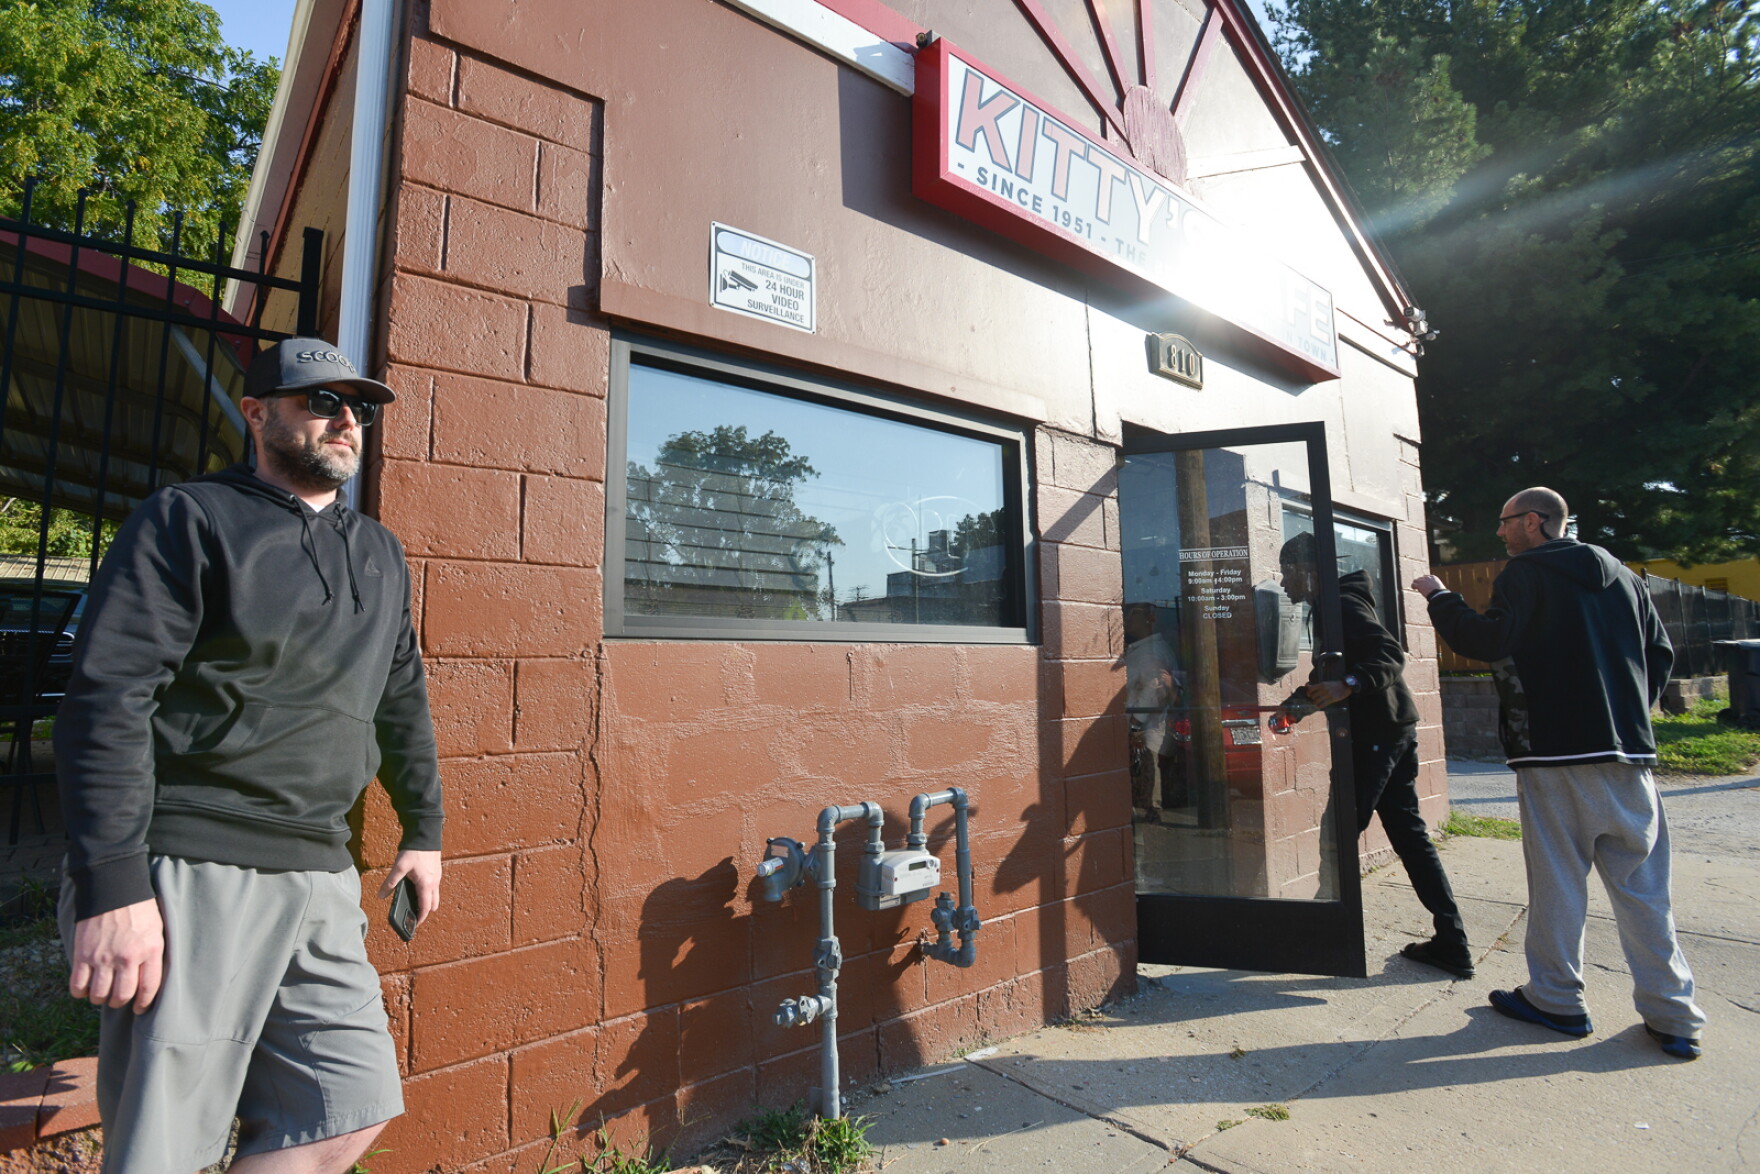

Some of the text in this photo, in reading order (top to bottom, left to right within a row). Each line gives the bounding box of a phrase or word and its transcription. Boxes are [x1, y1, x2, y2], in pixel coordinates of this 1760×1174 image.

[741, 262, 757, 274] THIS
[757, 267, 775, 280] AREA
[976, 166, 1043, 214] SINCE
[1052, 205, 1092, 239] 1951
[1115, 237, 1147, 263] THE
[1297, 334, 1327, 361] TOWN
[765, 279, 805, 301] 24 HOUR
[747, 298, 805, 324] SURVEILLANCE
[771, 293, 800, 311] VIDEO
[1167, 344, 1195, 377] 810
[1179, 549, 1248, 560] HOURS OF OPERATION
[1188, 570, 1215, 578] Monday
[1220, 568, 1242, 577] Friday
[1201, 587, 1231, 595] Saturday
